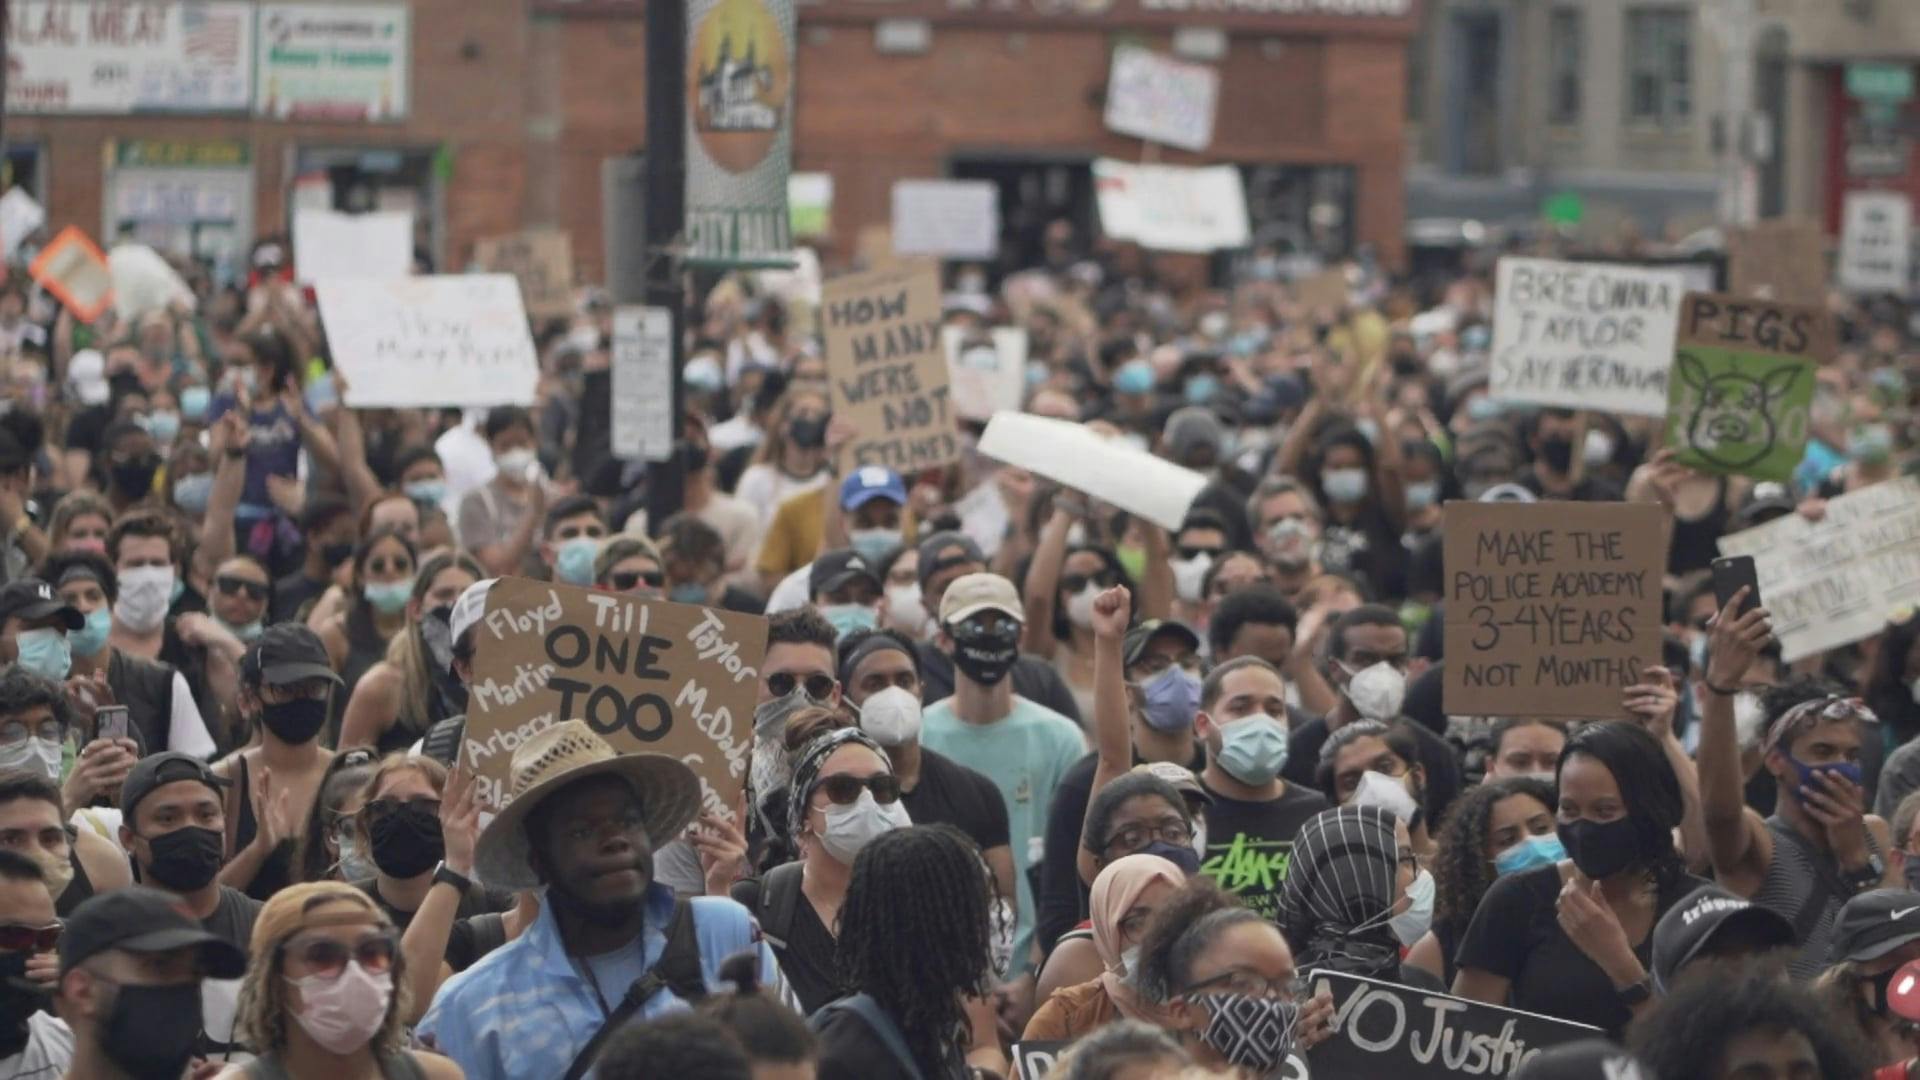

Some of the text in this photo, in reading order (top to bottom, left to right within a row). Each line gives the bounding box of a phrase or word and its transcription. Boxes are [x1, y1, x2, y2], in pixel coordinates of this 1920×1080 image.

[829, 291, 906, 328] HOW
[1690, 300, 1810, 354] PIGS
[851, 321, 941, 361] MANY
[839, 363, 919, 404] WERE
[883, 385, 949, 432] NOT
[1476, 530, 1624, 567] MAKE THE
[1454, 568, 1648, 603] POLICE ACADEMY
[485, 590, 563, 640] Floyd
[587, 593, 649, 635] Till
[545, 625, 673, 680] ONE
[687, 608, 757, 683] Taylor
[473, 663, 556, 712] Martin
[1463, 654, 1642, 688] NOT MONTHS
[547, 677, 673, 743] TOO
[674, 679, 749, 778] McDade
[465, 711, 553, 769] Arbery
[1410, 997, 1542, 1077] Justi
